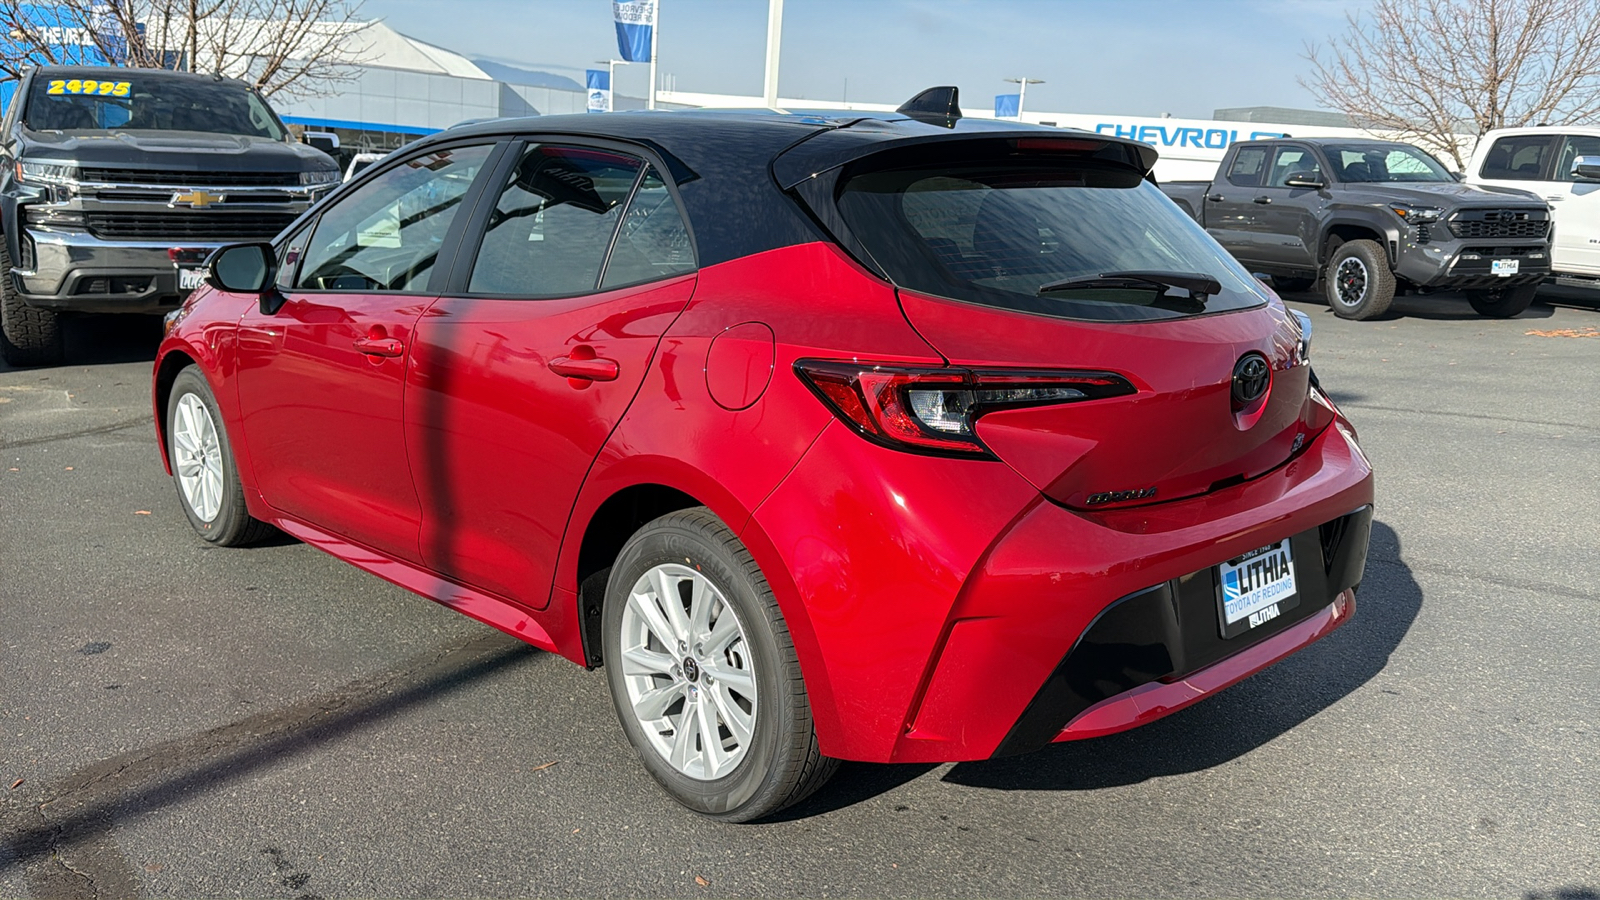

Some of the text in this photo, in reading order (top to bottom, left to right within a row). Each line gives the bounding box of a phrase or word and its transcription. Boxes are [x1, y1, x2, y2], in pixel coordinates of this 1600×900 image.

[48, 80, 131, 96] 24995
[1095, 123, 1284, 150] CHEVROL
[1238, 551, 1290, 596] LITHIA
[1225, 578, 1293, 615] TOYOTA OF REDDING
[1255, 603, 1280, 626] LITHIA
